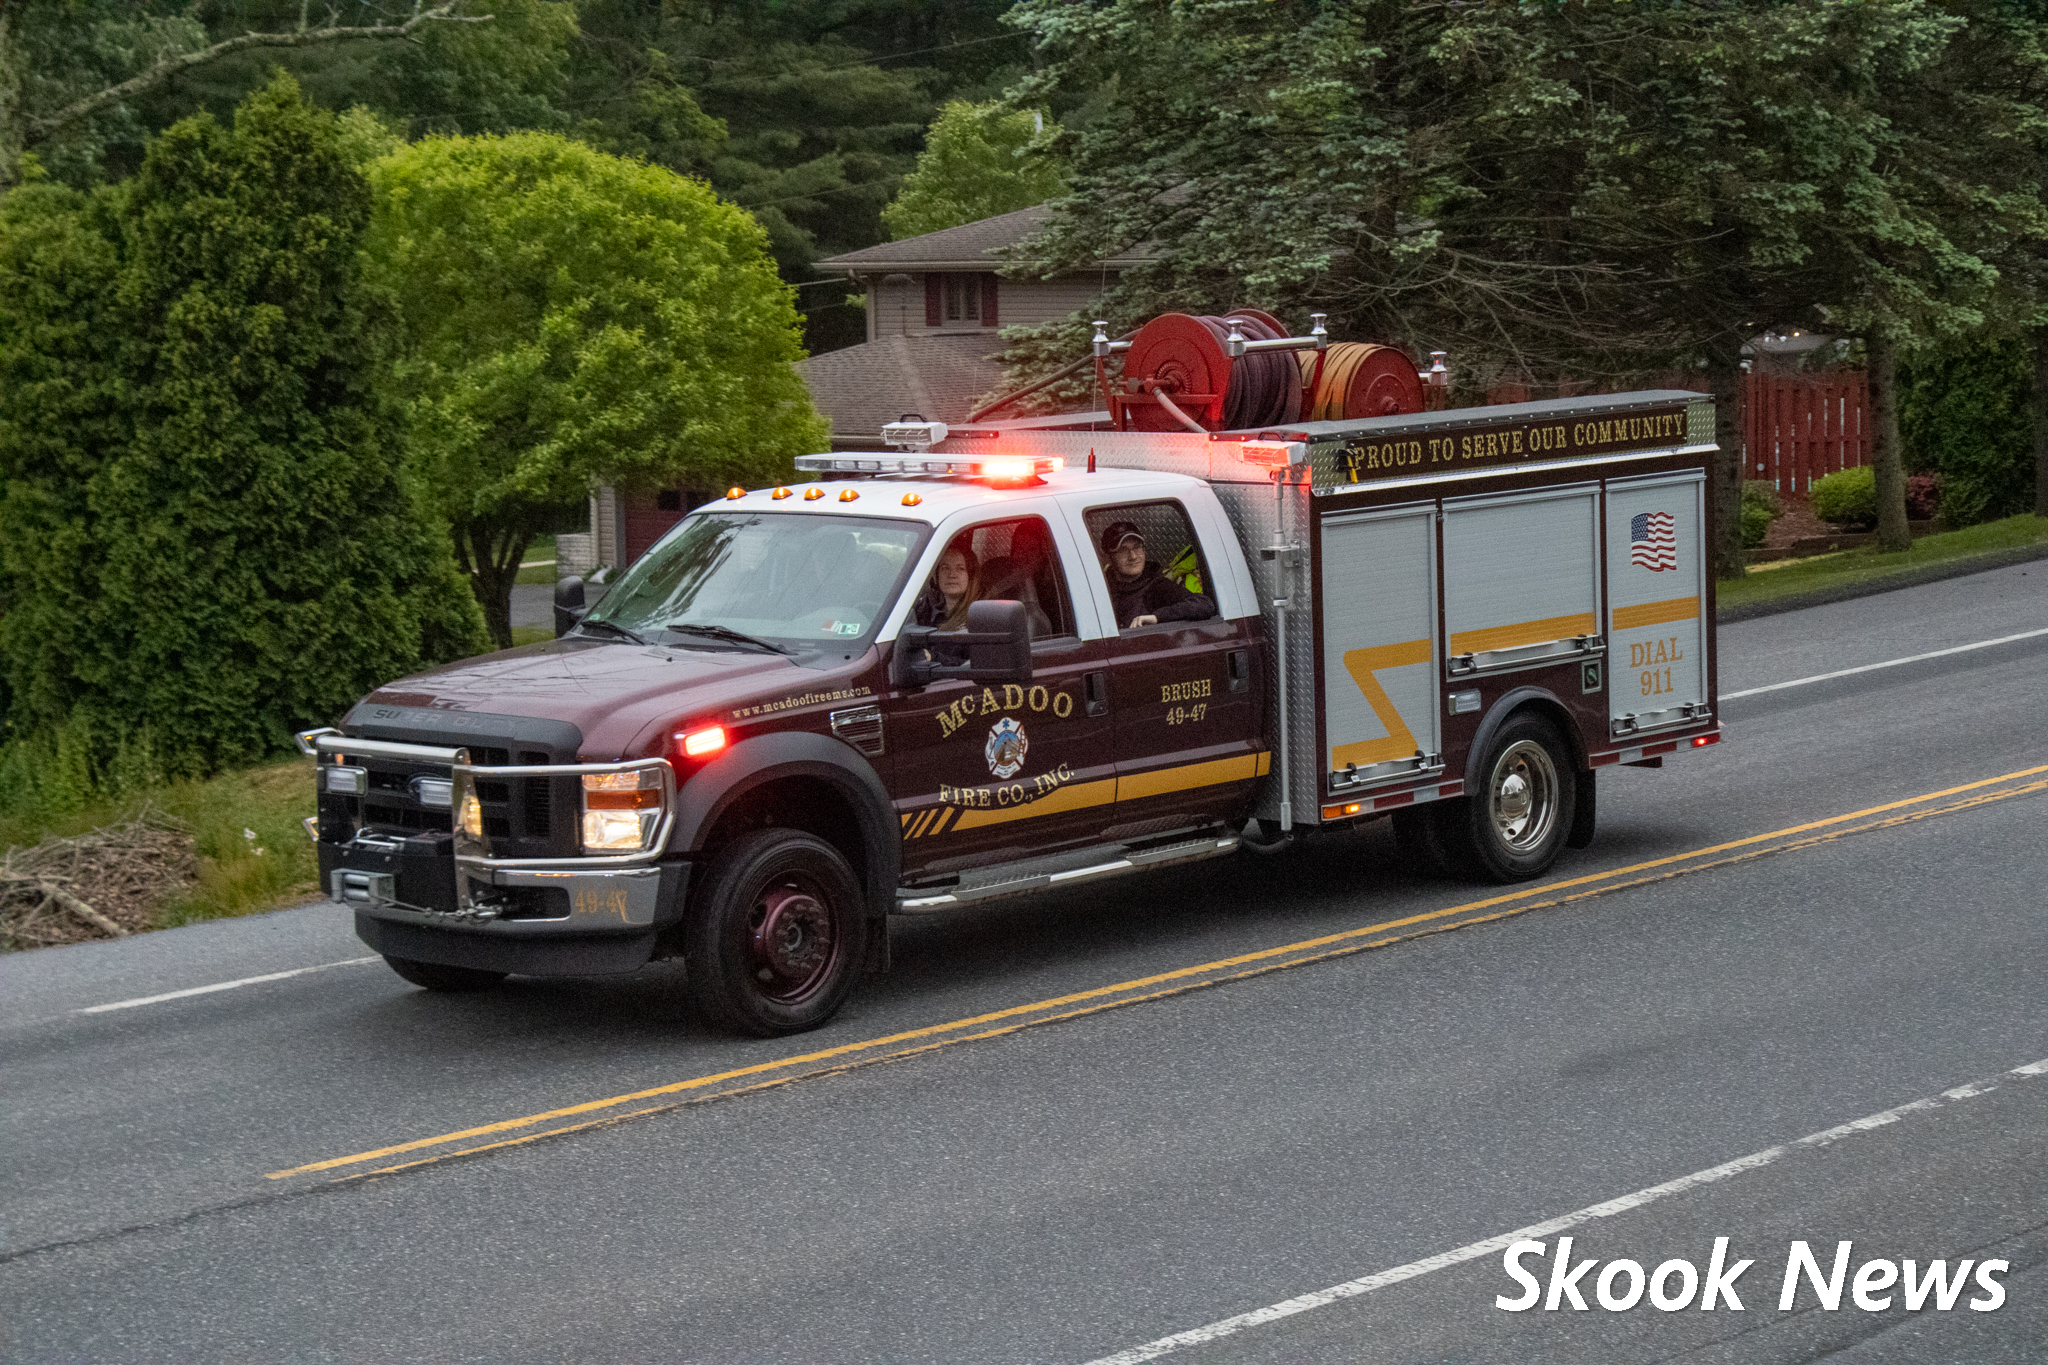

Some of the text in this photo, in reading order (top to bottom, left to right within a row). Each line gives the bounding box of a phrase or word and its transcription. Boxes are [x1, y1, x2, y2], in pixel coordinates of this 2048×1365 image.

[1354, 413, 1684, 471] PROUD TO SERVE OUR COMMUNITY
[1629, 637, 1683, 668] DIAL
[1160, 679, 1212, 703] BRUSH
[1640, 666, 1674, 696] 911
[732, 685, 872, 719] www.mcadoofireems.com
[1166, 703, 1207, 726] 49-47
[938, 783, 991, 807] FIRE
[1034, 761, 1075, 796] INC.
